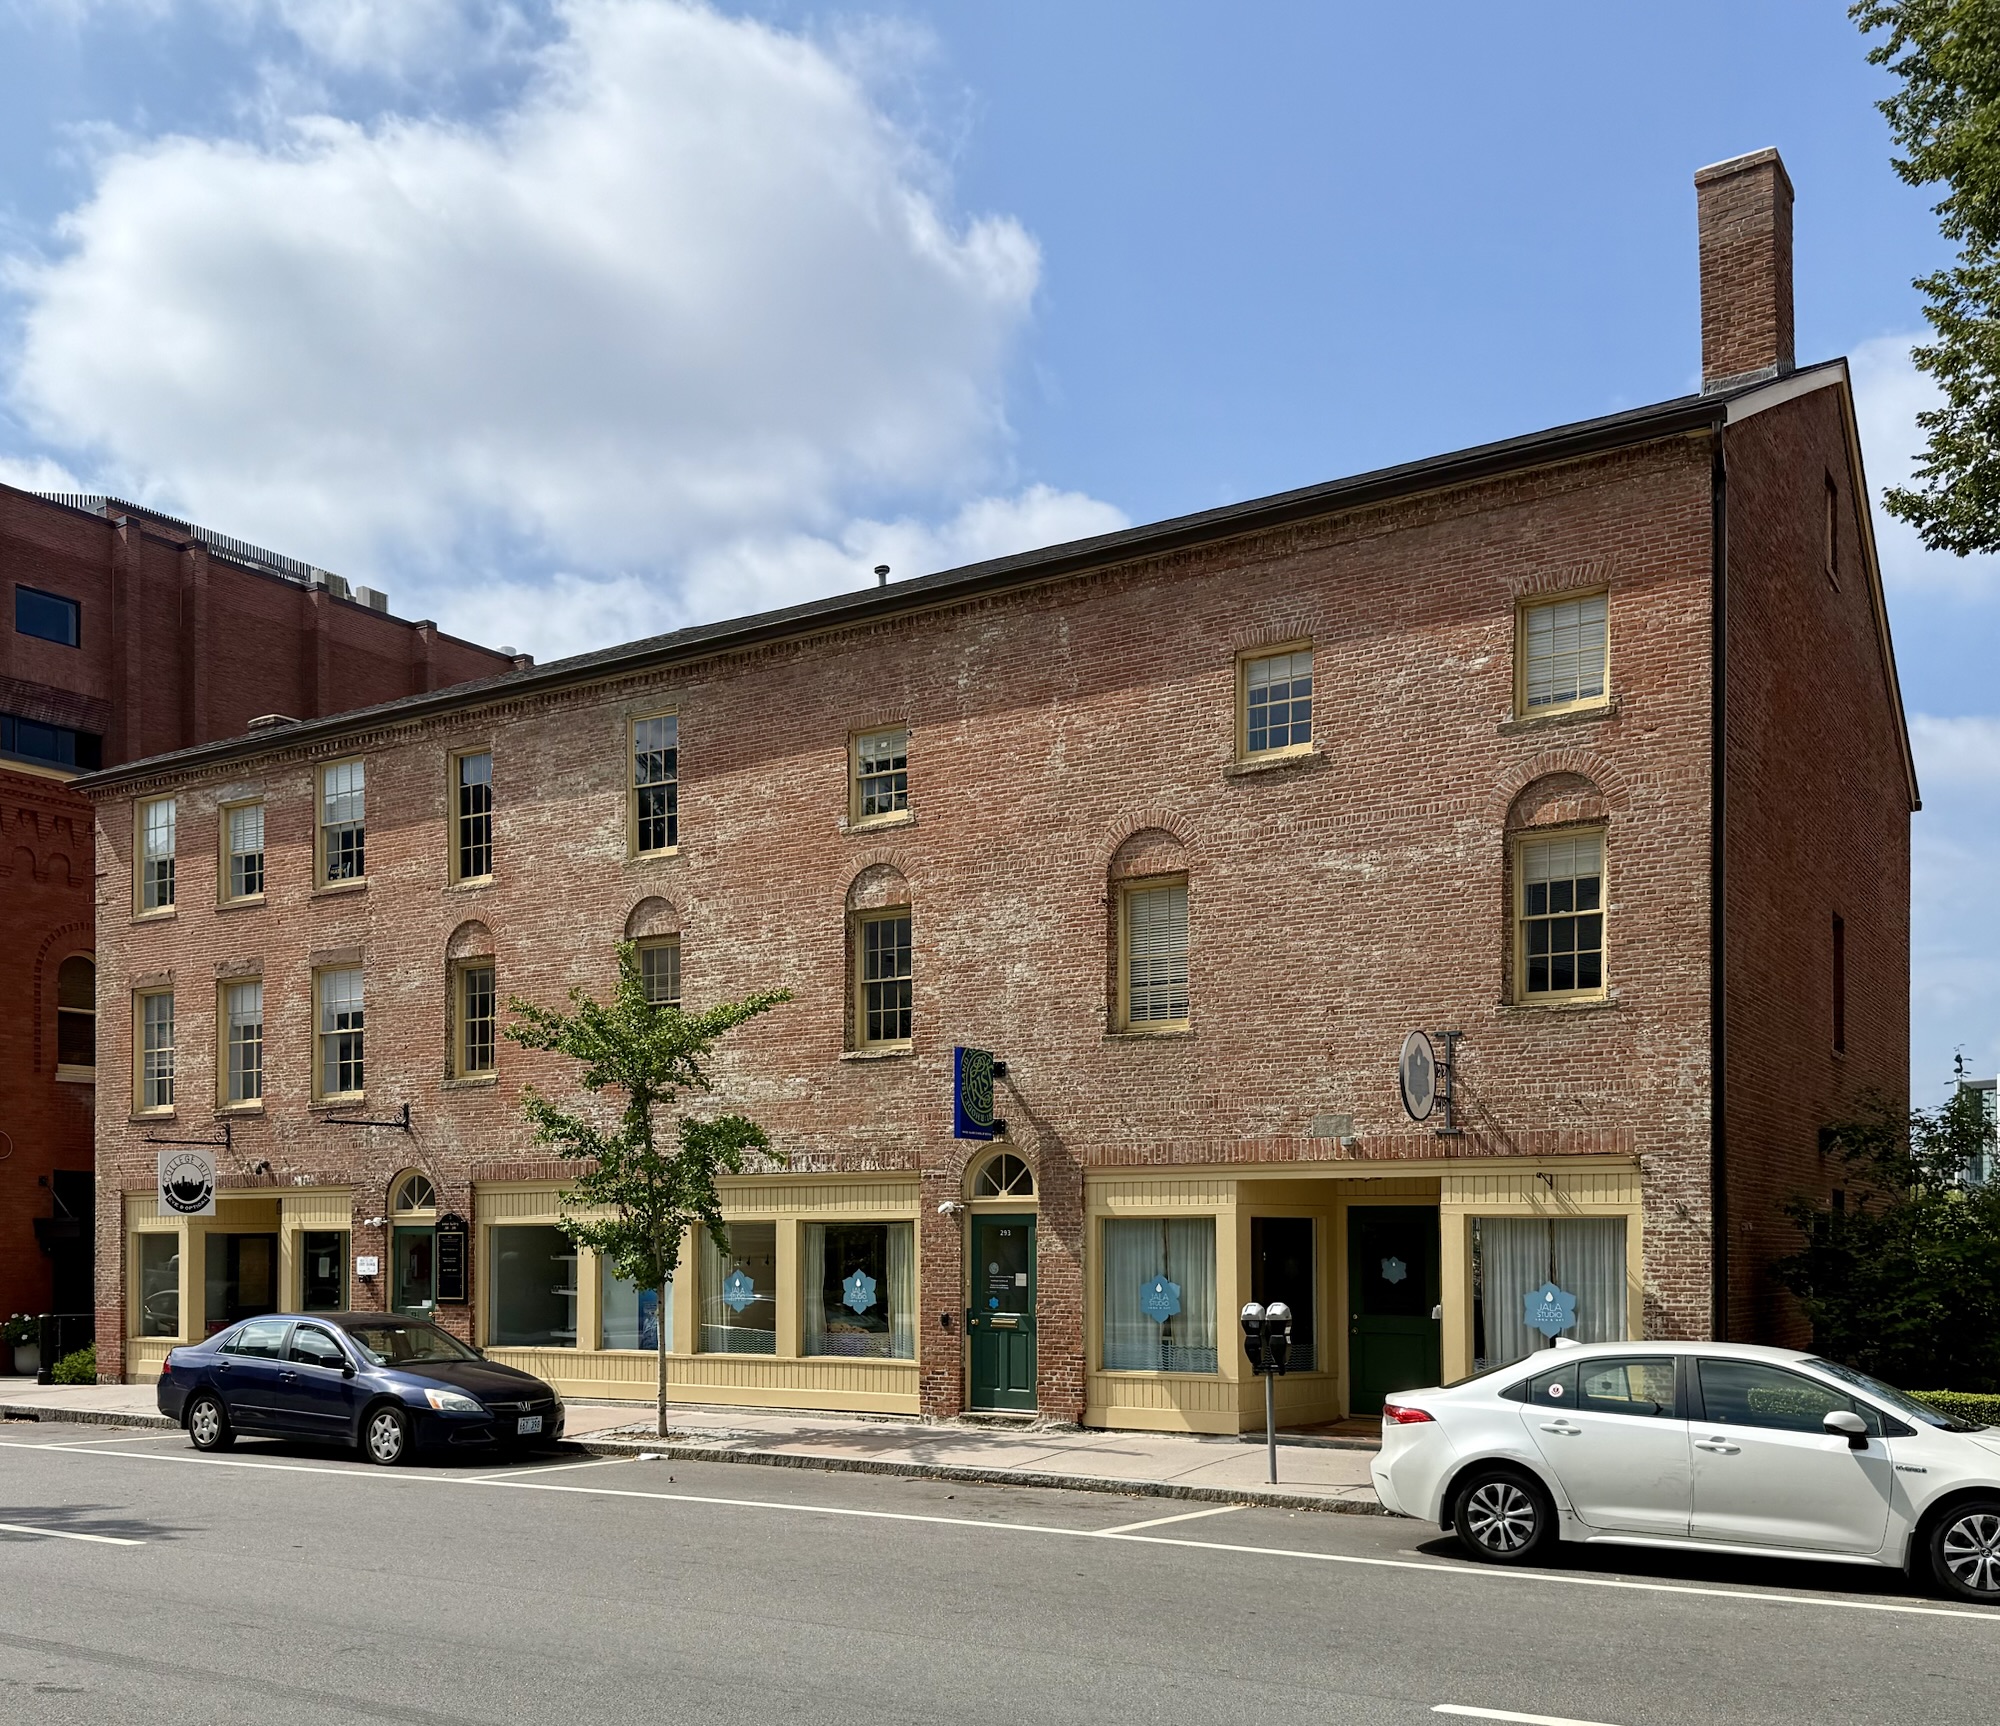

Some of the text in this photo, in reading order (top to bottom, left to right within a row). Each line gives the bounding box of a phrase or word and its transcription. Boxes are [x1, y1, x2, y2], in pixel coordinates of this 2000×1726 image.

[164, 1155, 211, 1183] COLLEGE HILL
[167, 1196, 180, 1208] EYE
[184, 1197, 209, 1211] OPTICAL
[999, 1229, 1012, 1237] 293
[1537, 1303, 1563, 1312] JALA
